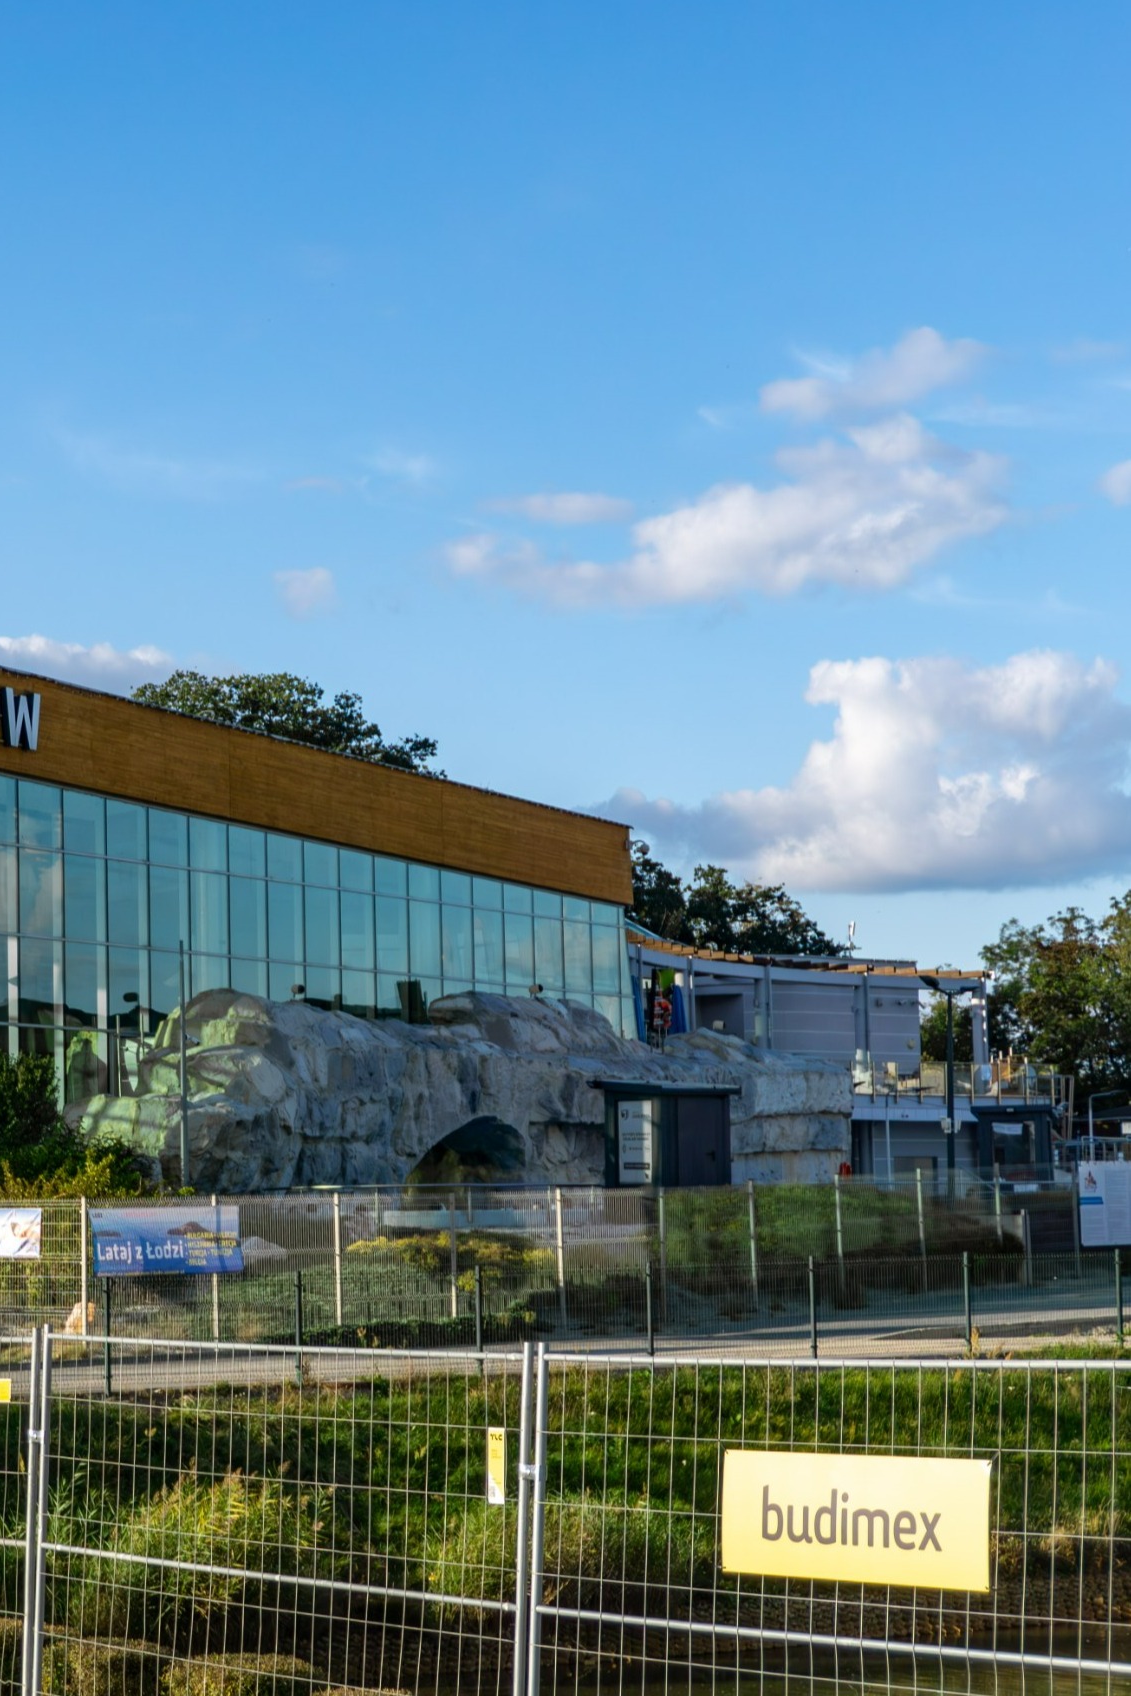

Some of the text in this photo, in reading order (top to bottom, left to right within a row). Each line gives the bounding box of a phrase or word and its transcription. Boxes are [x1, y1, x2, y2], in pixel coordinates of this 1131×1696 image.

[97, 1239, 184, 1264] Lataj z Łodzi
[761, 1484, 943, 1552] budimex
